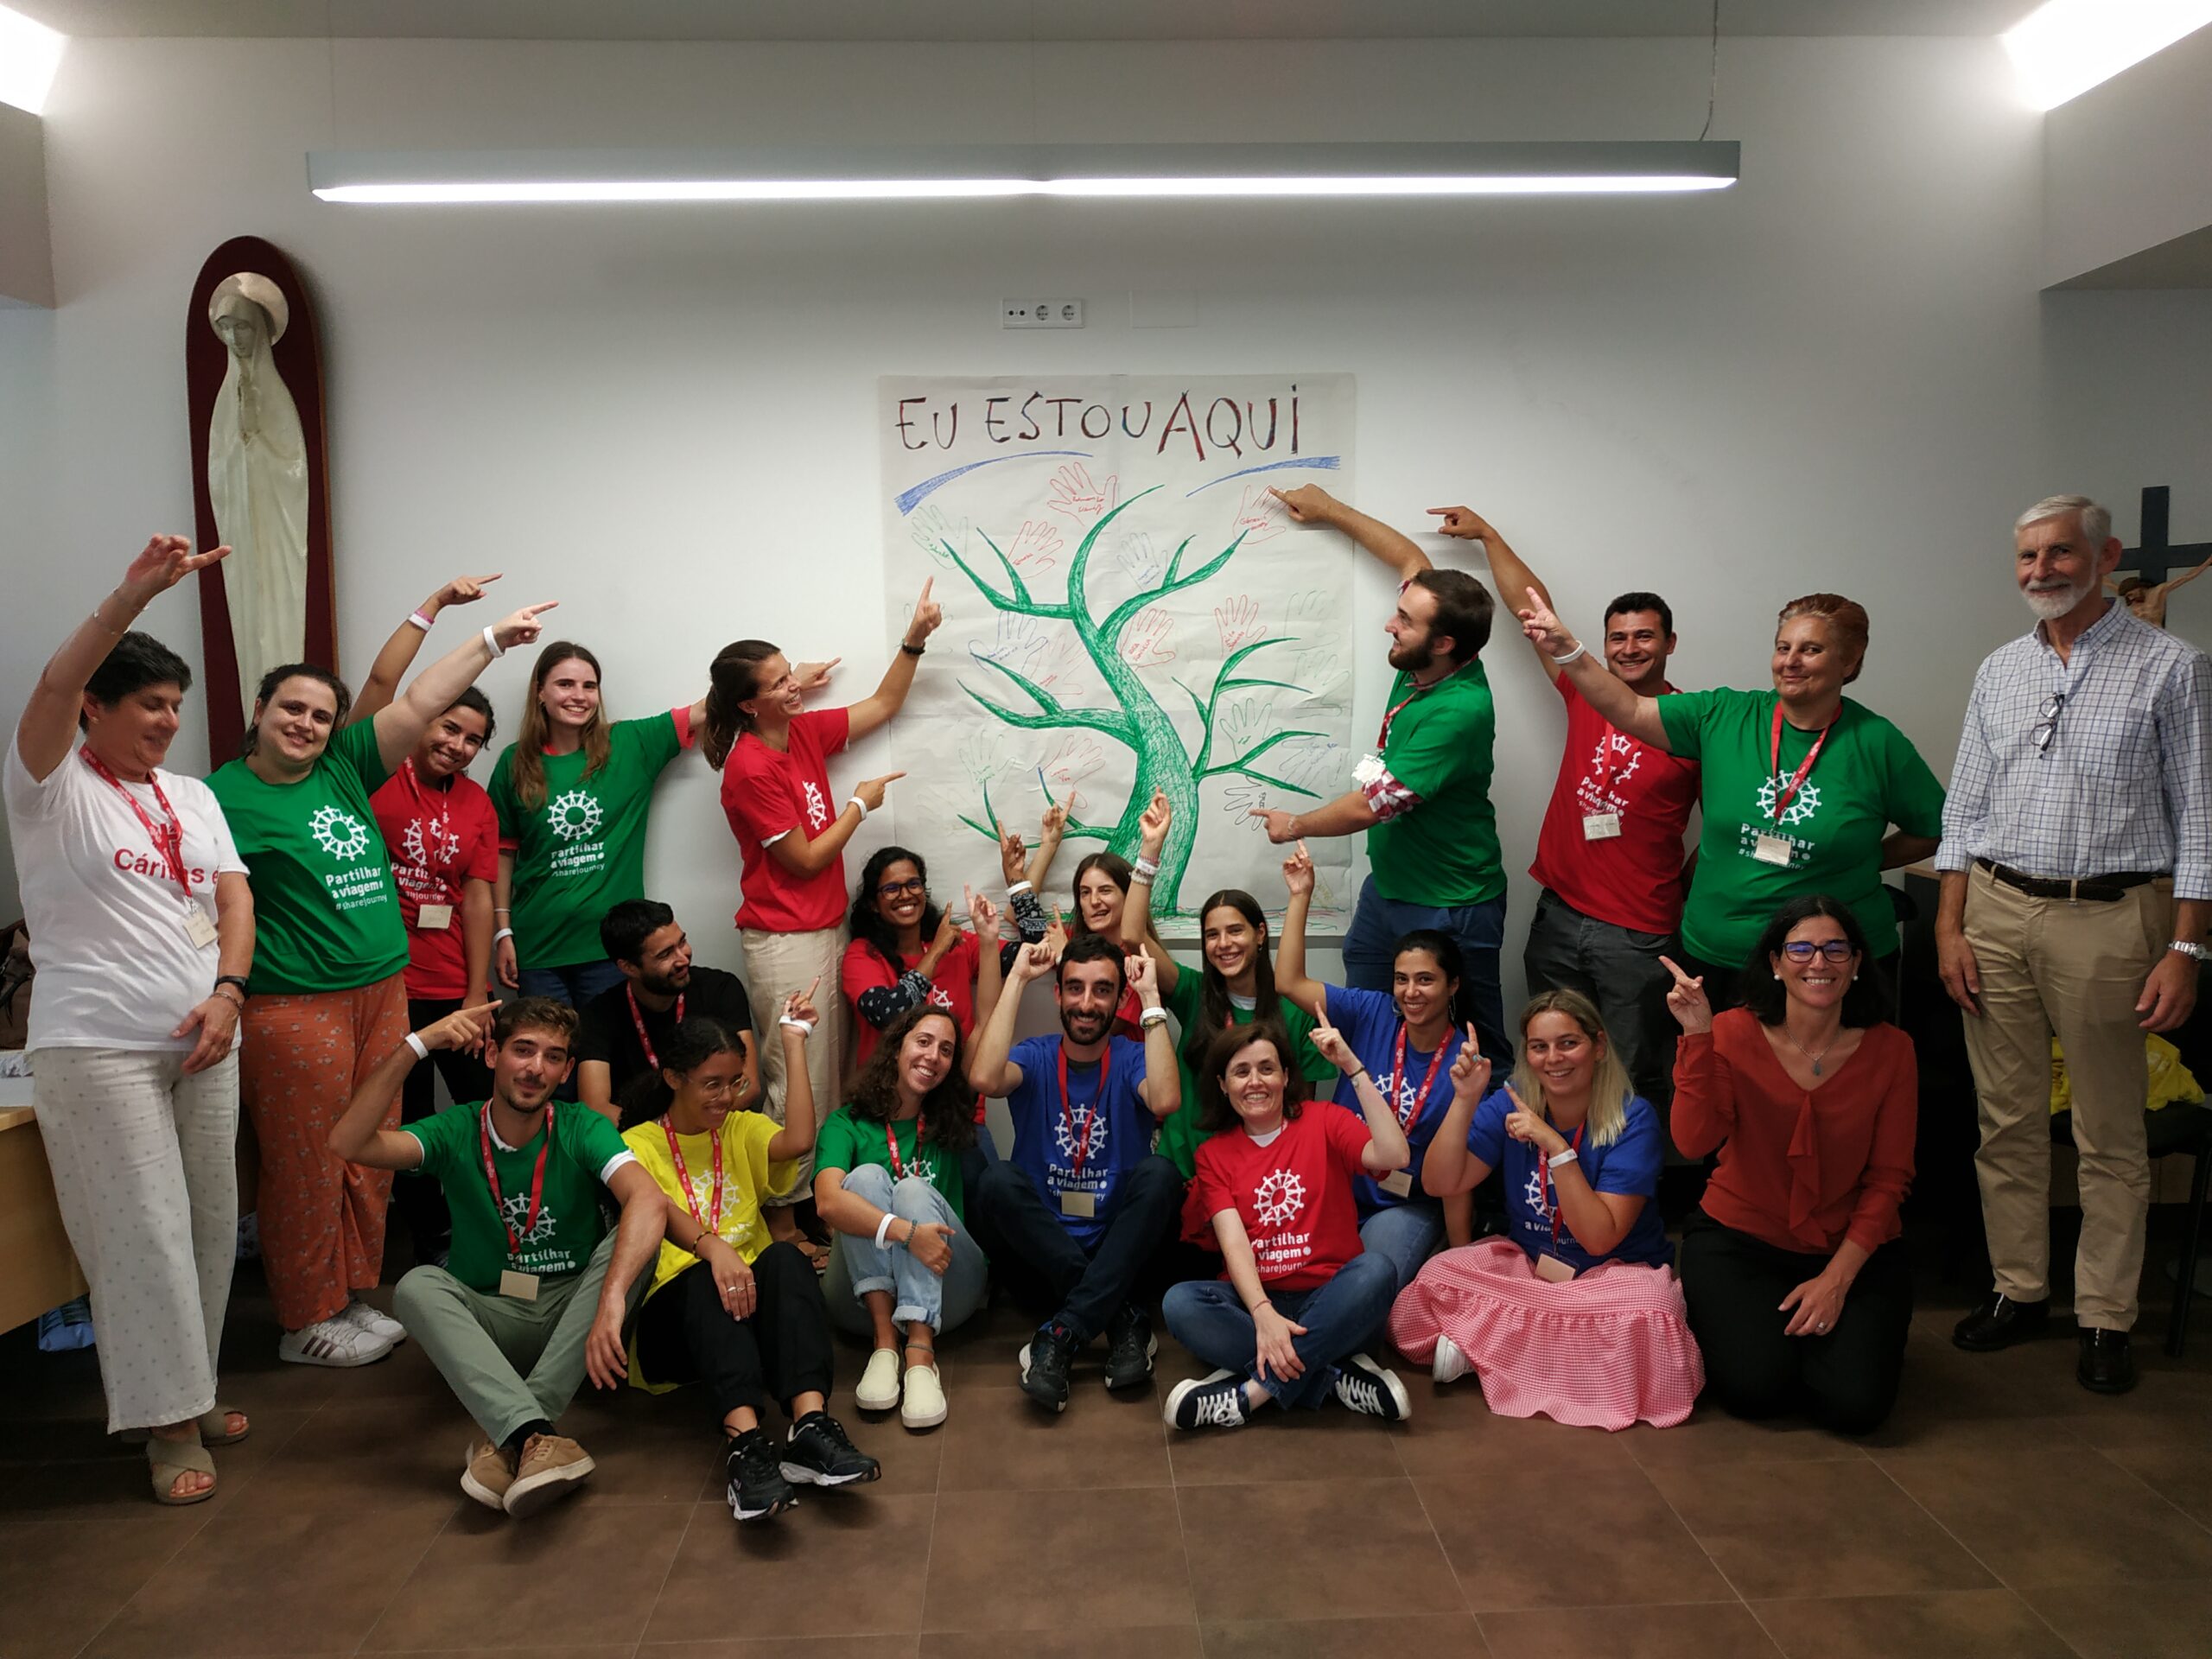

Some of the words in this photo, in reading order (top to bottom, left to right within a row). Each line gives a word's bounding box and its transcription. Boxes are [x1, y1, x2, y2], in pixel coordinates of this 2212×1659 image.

[895, 397, 957, 450] EU
[984, 391, 1152, 443] ESTOU
[557, 854, 596, 868] viagem
[325, 866, 382, 887] Partilhar
[331, 889, 340, 899] a
[339, 880, 379, 898] viagem
[335, 894, 388, 911] #sharejourney
[1046, 1176, 1054, 1185] a
[1056, 1178, 1098, 1190] viagem
[1258, 1248, 1302, 1263] viagem
